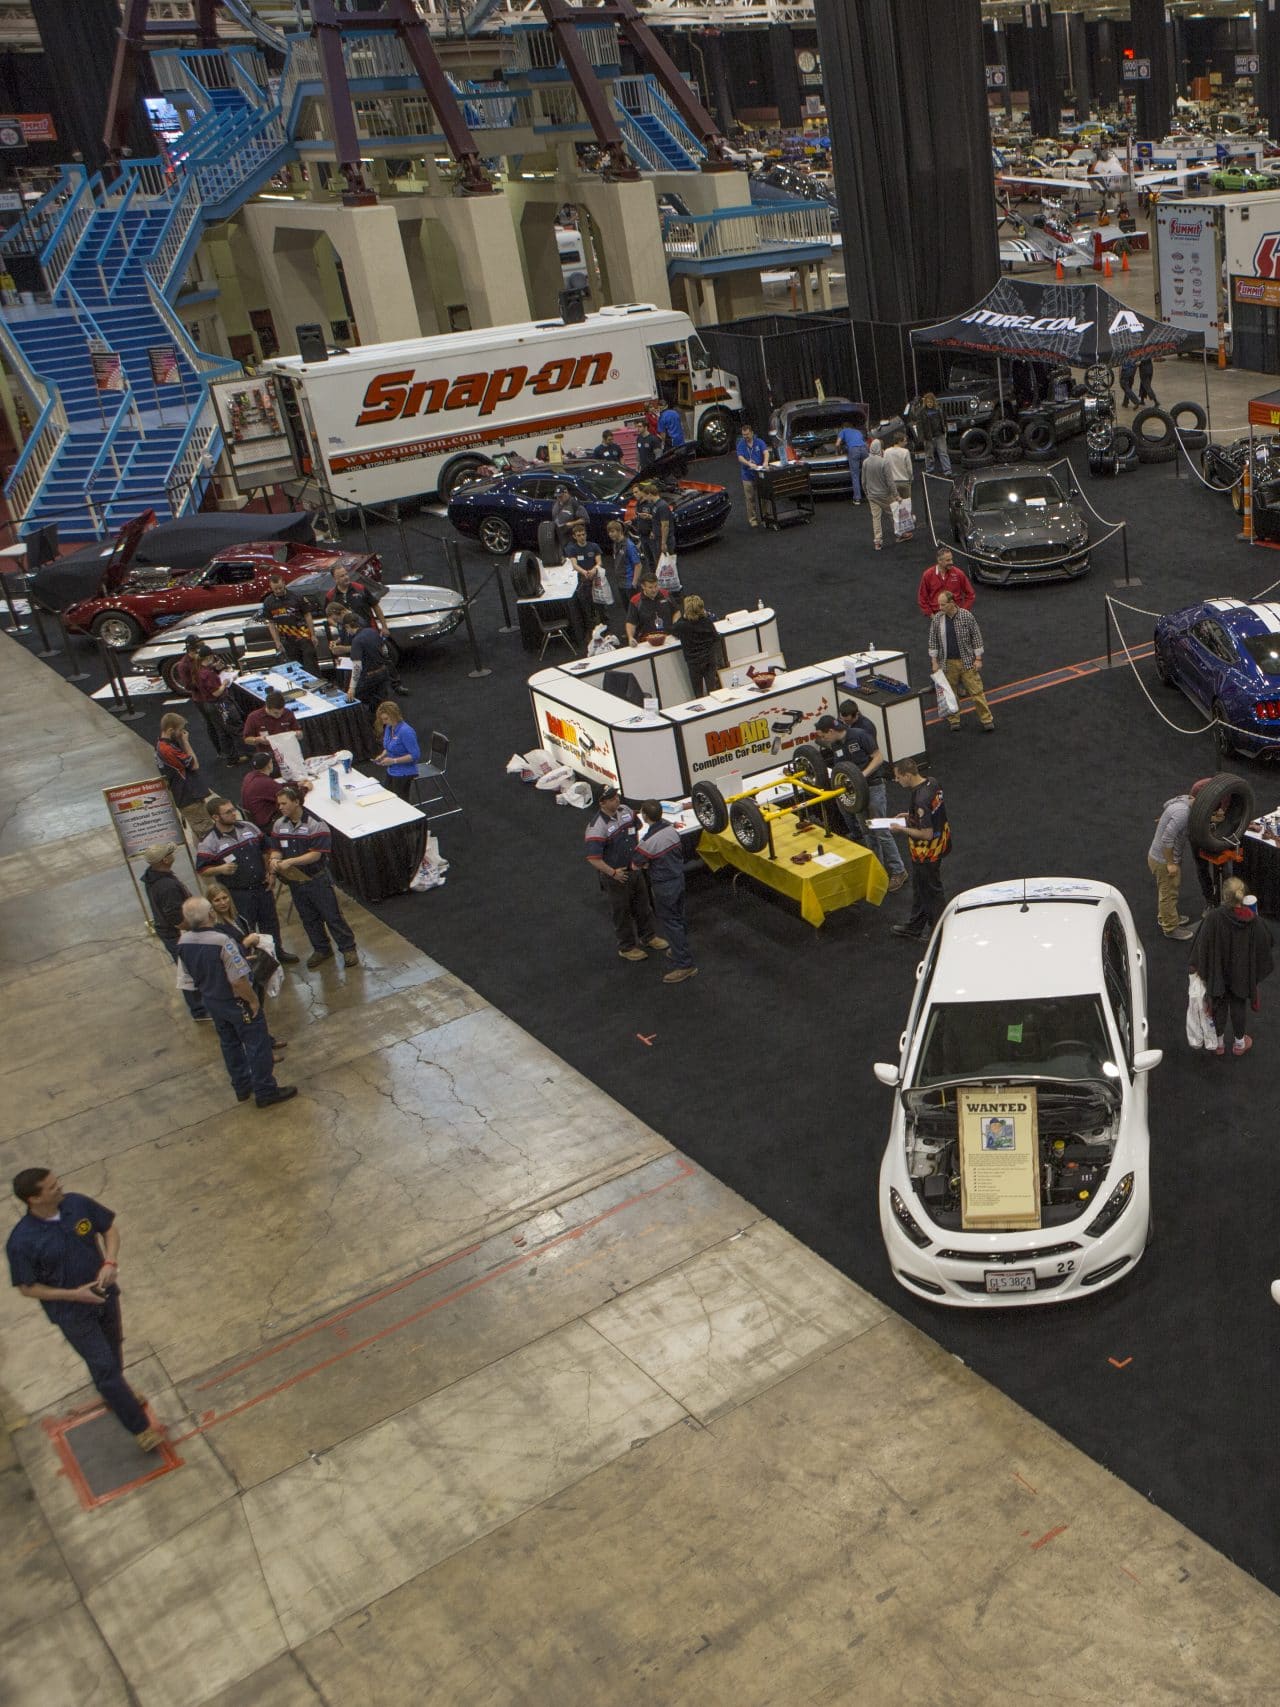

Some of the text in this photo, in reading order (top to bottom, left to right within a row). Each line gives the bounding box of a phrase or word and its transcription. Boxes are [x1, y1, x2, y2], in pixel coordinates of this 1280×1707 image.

[355, 351, 613, 427] Snap-on
[344, 432, 482, 465] www.snapon.com
[704, 718, 770, 757] RADAIR
[692, 741, 772, 773] Complete Car Care
[110, 781, 163, 798] Register Here!
[966, 1102, 1028, 1113] WANTED
